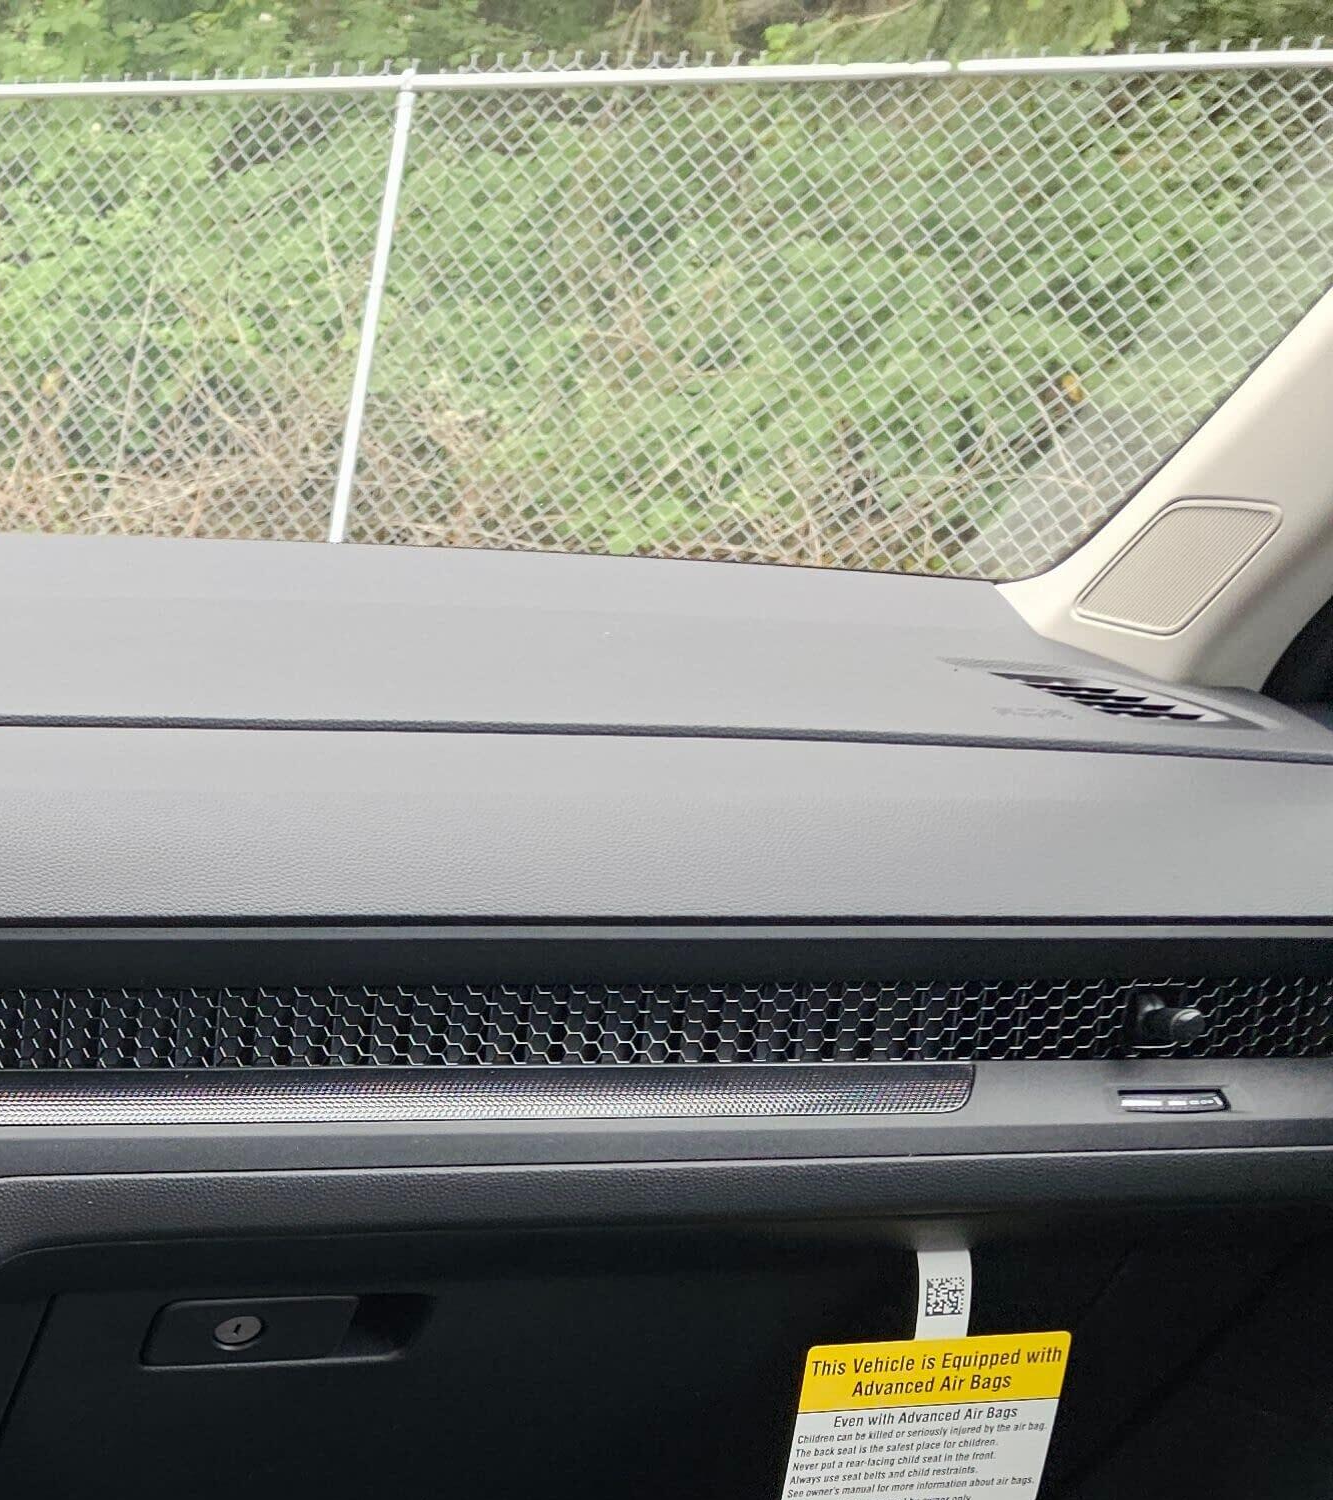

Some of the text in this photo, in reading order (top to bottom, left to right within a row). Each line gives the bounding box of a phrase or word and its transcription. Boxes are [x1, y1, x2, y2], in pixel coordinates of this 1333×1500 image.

[812, 1346, 1063, 1377] This Vehicle is Equipped with
[851, 1374, 1012, 1397] Advanced Air Bags
[834, 1406, 1018, 1428] Even with Advanced Air Bags
[797, 1434, 835, 1444] Children
[837, 1434, 853, 1442] can
[855, 1432, 866, 1441] be
[868, 1430, 894, 1440] killed
[895, 1431, 905, 1439] or
[907, 1426, 947, 1438] seriously
[950, 1424, 982, 1436] injured
[984, 1424, 994, 1434] by
[997, 1422, 1011, 1432] the
[1013, 1422, 1026, 1431] air
[795, 1449, 811, 1458] The
[813, 1447, 835, 1457] back
[837, 1445, 857, 1455] seat
[859, 1444, 867, 1454] is
[870, 1443, 884, 1453] the
[886, 1442, 914, 1452] safest
[916, 1440, 941, 1452] place
[943, 1439, 956, 1449] for
[793, 1462, 819, 1472] Never
[820, 1461, 835, 1472] put
[846, 1456, 895, 1468] rear-facing
[897, 1455, 921, 1465] child
[922, 1454, 942, 1464] seat
[944, 1453, 953, 1462] in
[955, 1452, 970, 1461] the
[789, 1475, 822, 1485] Always
[823, 1475, 838, 1483] use
[841, 1472, 862, 1482] seat
[863, 1470, 886, 1480] belts
[888, 1469, 905, 1479] and
[907, 1467, 931, 1477] child
[787, 1489, 804, 1499] See
[805, 1486, 840, 1497] owner's
[841, 1484, 875, 1495] manual
[877, 1483, 890, 1493] for
[891, 1482, 916, 1491] more
[916, 1480, 967, 1490] information
[969, 1478, 995, 1487] about
[996, 1476, 1009, 1486] air
